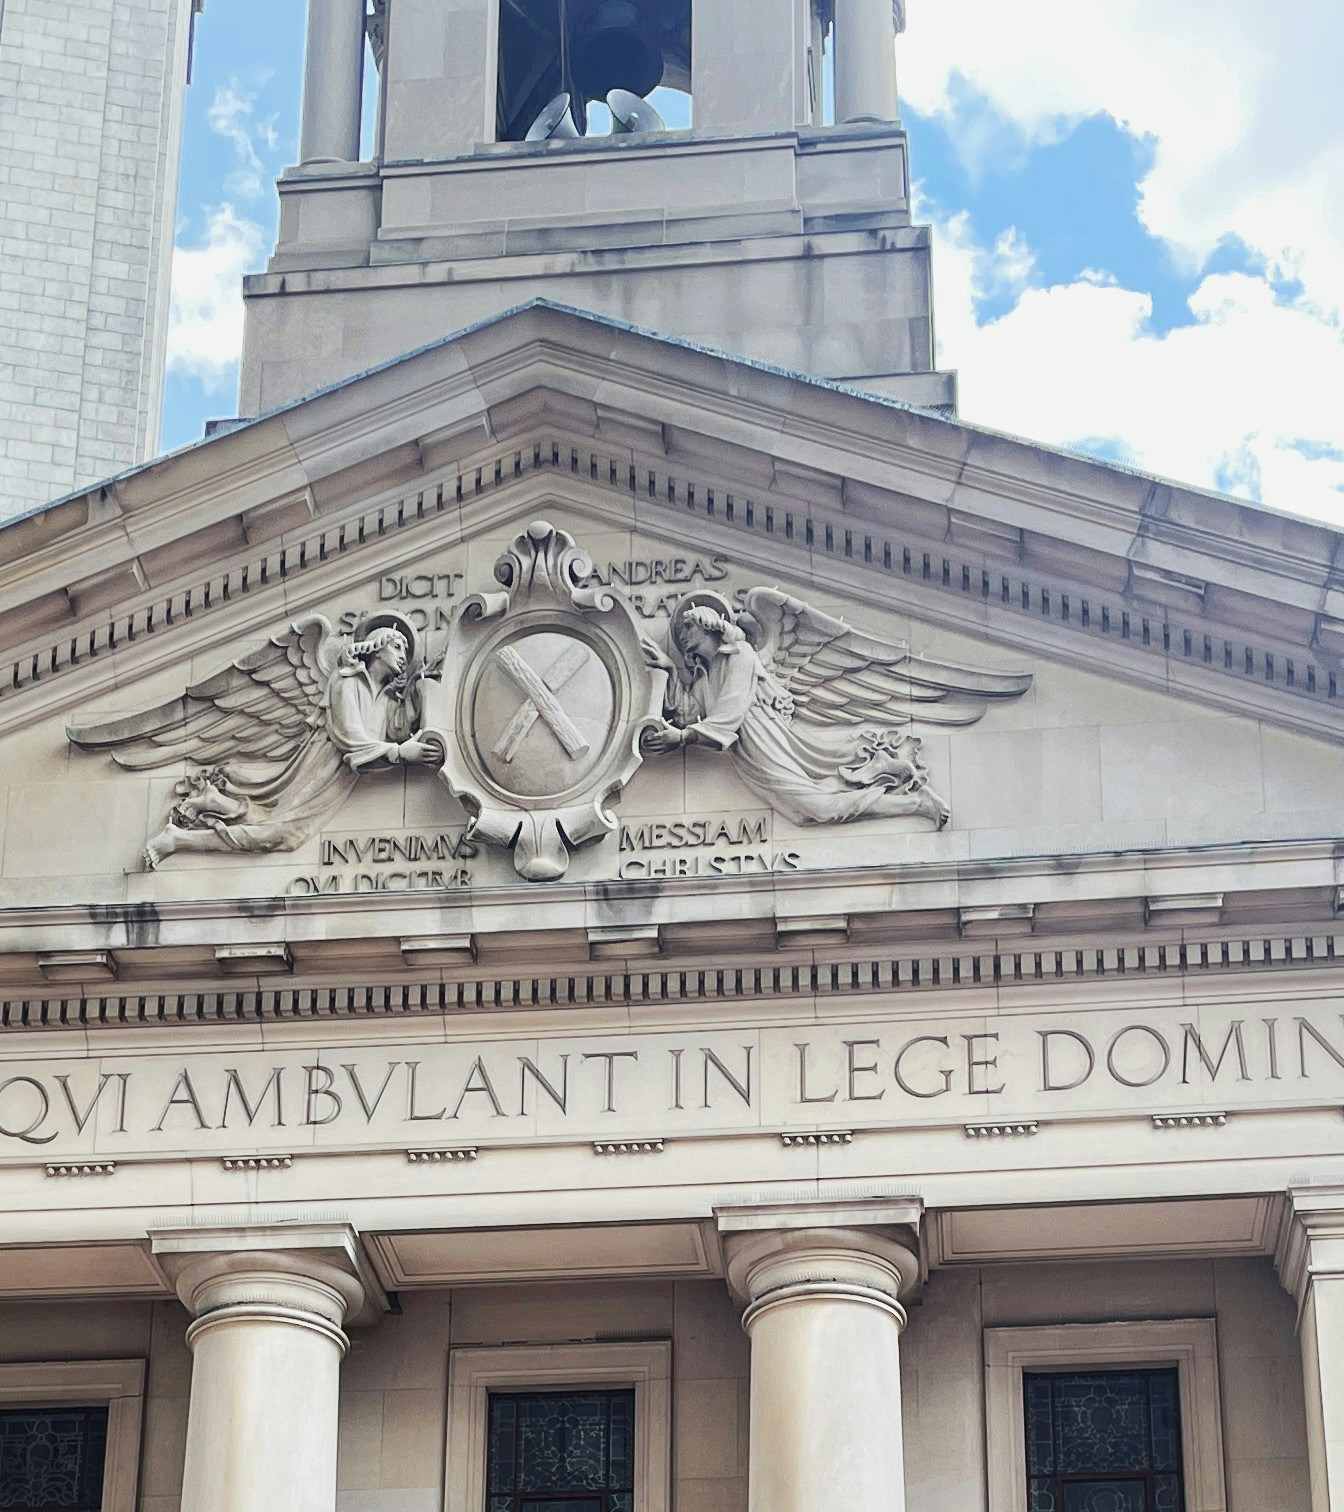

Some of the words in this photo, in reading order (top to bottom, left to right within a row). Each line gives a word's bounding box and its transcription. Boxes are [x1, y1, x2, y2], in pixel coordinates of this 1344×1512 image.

[379, 573, 464, 600] DICIT
[577, 555, 730, 588] ANDREAS
[618, 817, 768, 852] MESSIAM
[148, 1049, 640, 1133] AMBVLANT
[667, 1044, 756, 1111] IN
[792, 1031, 1007, 1105] LEGE
